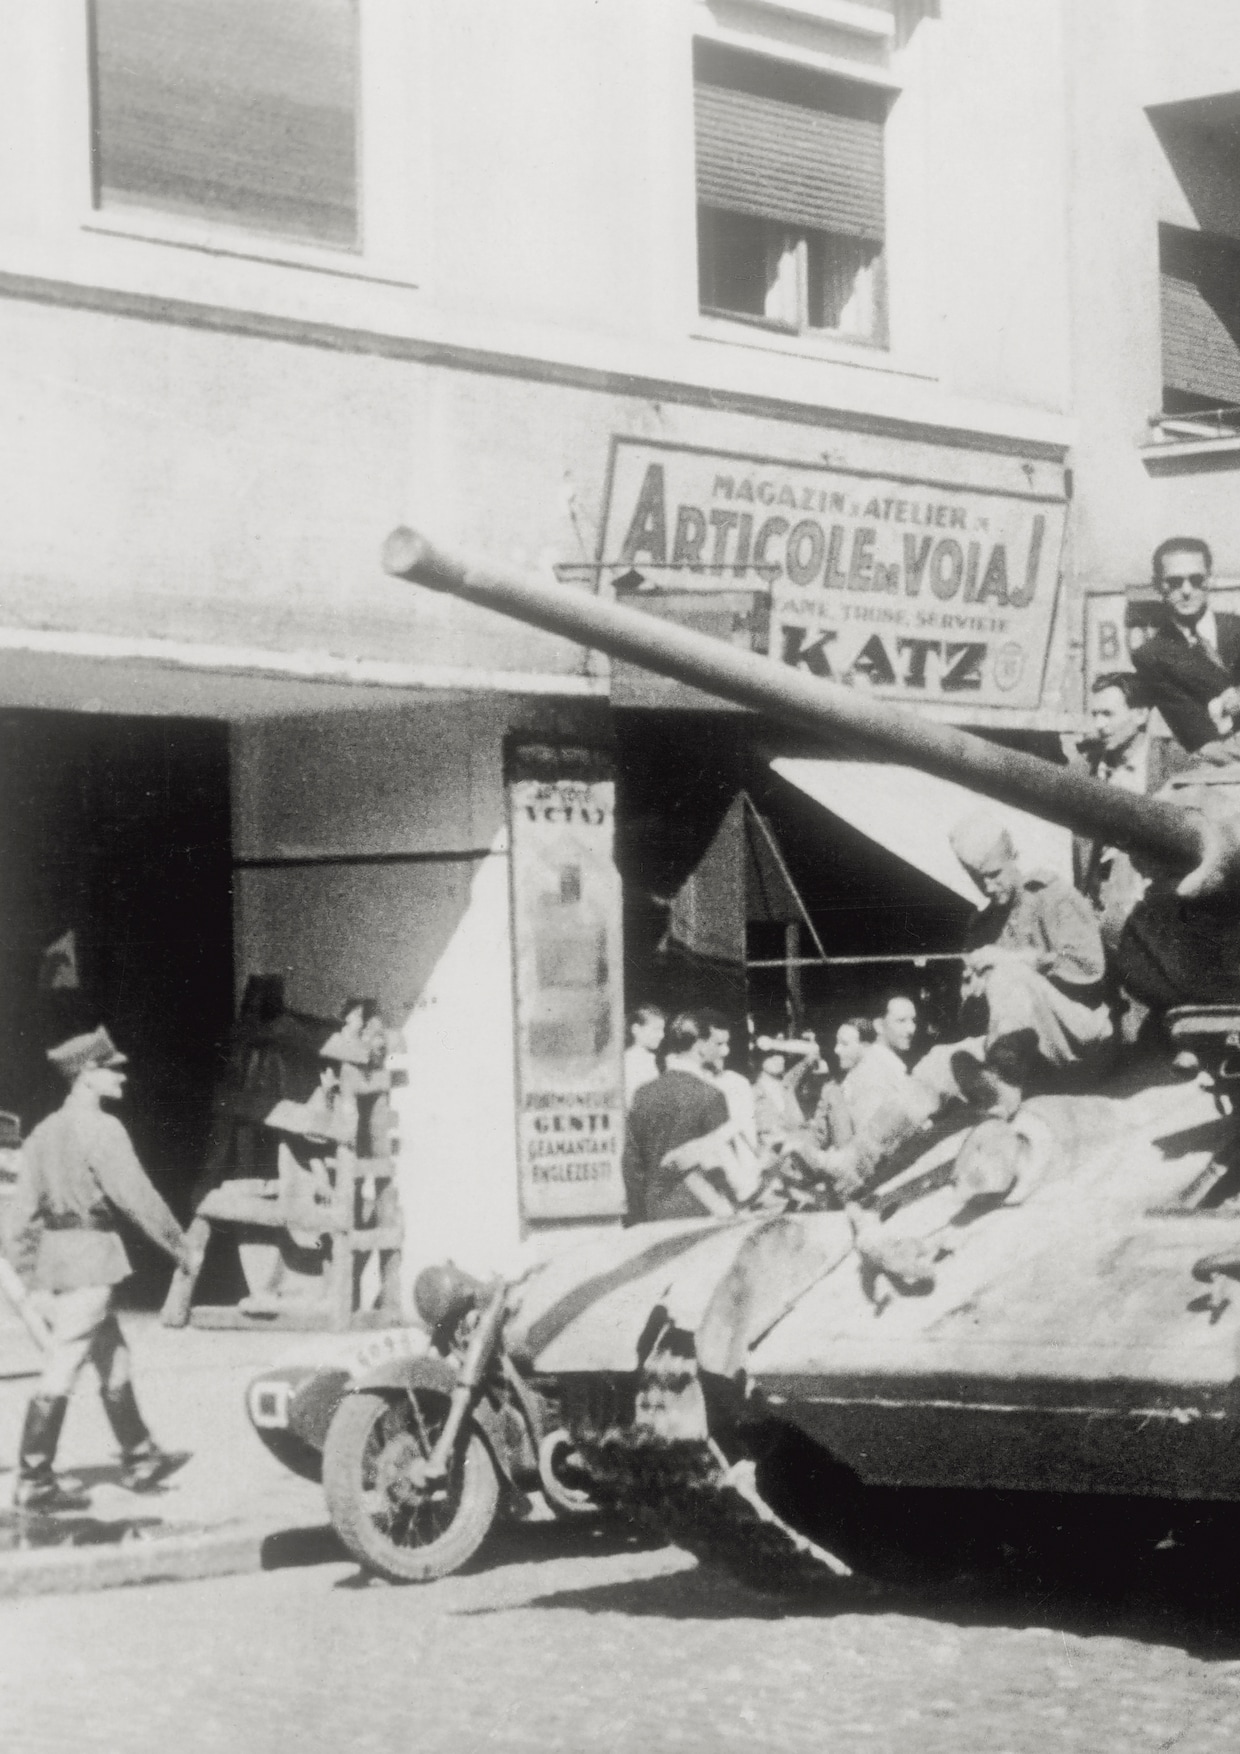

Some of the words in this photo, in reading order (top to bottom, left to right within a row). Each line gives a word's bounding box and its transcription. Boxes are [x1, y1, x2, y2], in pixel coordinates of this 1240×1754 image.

[620, 462, 878, 592] ARTICOLE
[902, 514, 1047, 609] VOIAJ
[712, 474, 846, 514] MAGAZIN
[863, 497, 968, 531] ATELIER
[780, 624, 990, 693] KATZ
